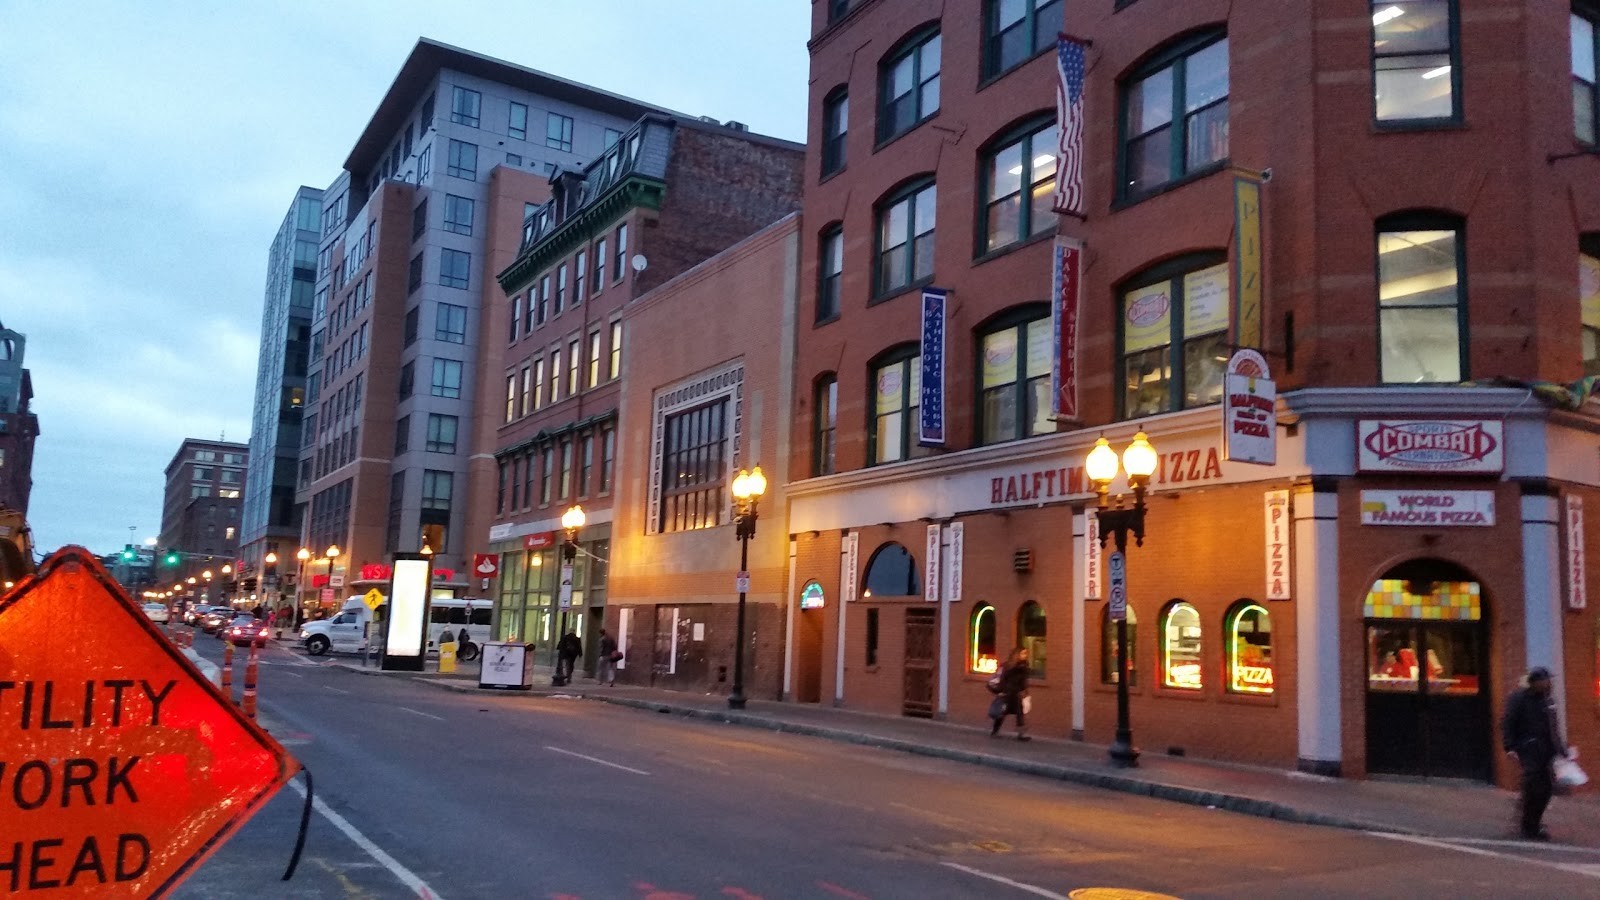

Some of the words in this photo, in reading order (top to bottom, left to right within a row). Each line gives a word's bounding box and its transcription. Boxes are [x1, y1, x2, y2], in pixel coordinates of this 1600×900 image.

[1062, 248, 1071, 310] DANCE
[923, 310, 932, 372] BEACON
[933, 313, 942, 378] ATHLETIC
[922, 387, 930, 428] HILL
[933, 388, 941, 428] CLUBS
[1234, 420, 1270, 438] PIZZA
[1382, 427, 1478, 453] COMBAT
[1152, 446, 1223, 484] IZZA
[1371, 511, 1437, 522] FAMOUS
[1440, 511, 1487, 523] PIZZA
[1398, 496, 1455, 507] WORLD
[928, 535, 937, 598] PIZZA
[1271, 508, 1283, 594] PIZZA
[1571, 511, 1581, 603] PIZZA
[1237, 665, 1273, 685] PIZZA
[0, 756, 140, 810] ORK
